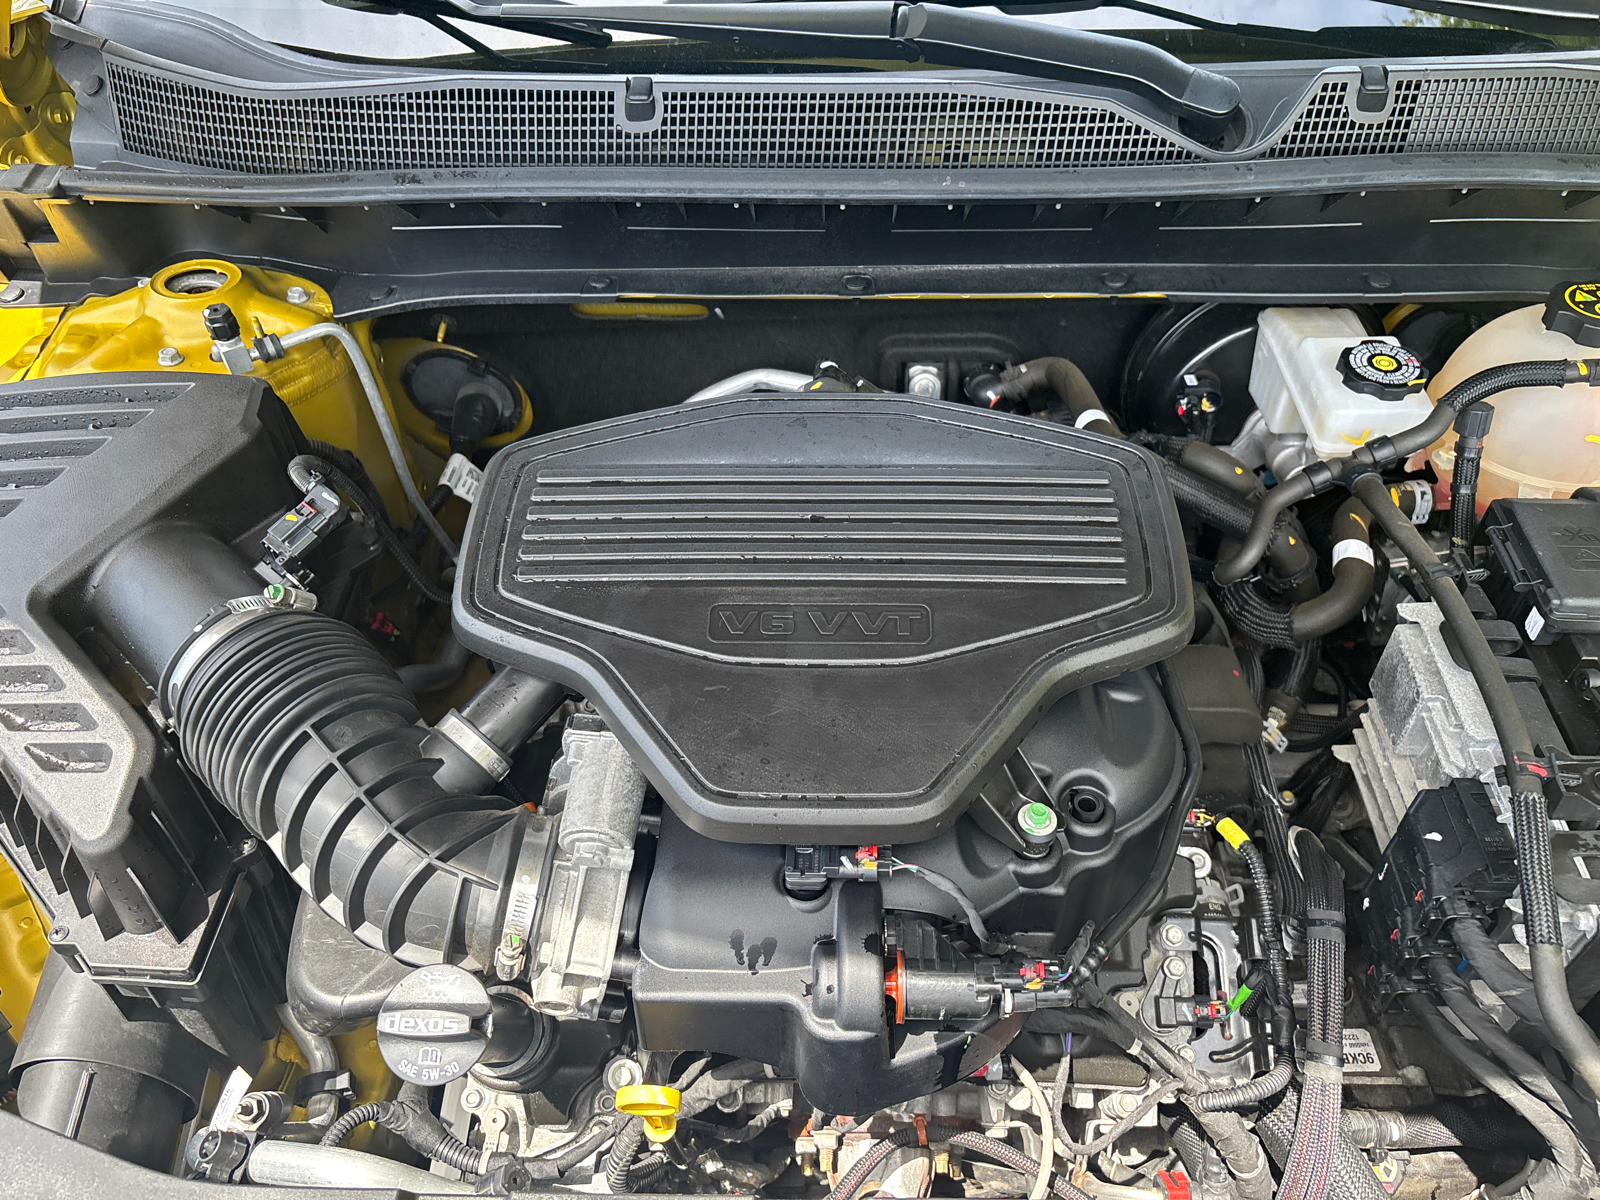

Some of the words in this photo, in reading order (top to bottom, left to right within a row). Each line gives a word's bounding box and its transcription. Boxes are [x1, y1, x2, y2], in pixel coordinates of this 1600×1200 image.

[718, 611, 794, 635] V6
[807, 611, 922, 636] VVT
[384, 1012, 459, 1033] dexos
[398, 1059, 419, 1078] SAE
[421, 1061, 460, 1081] 5W-30
